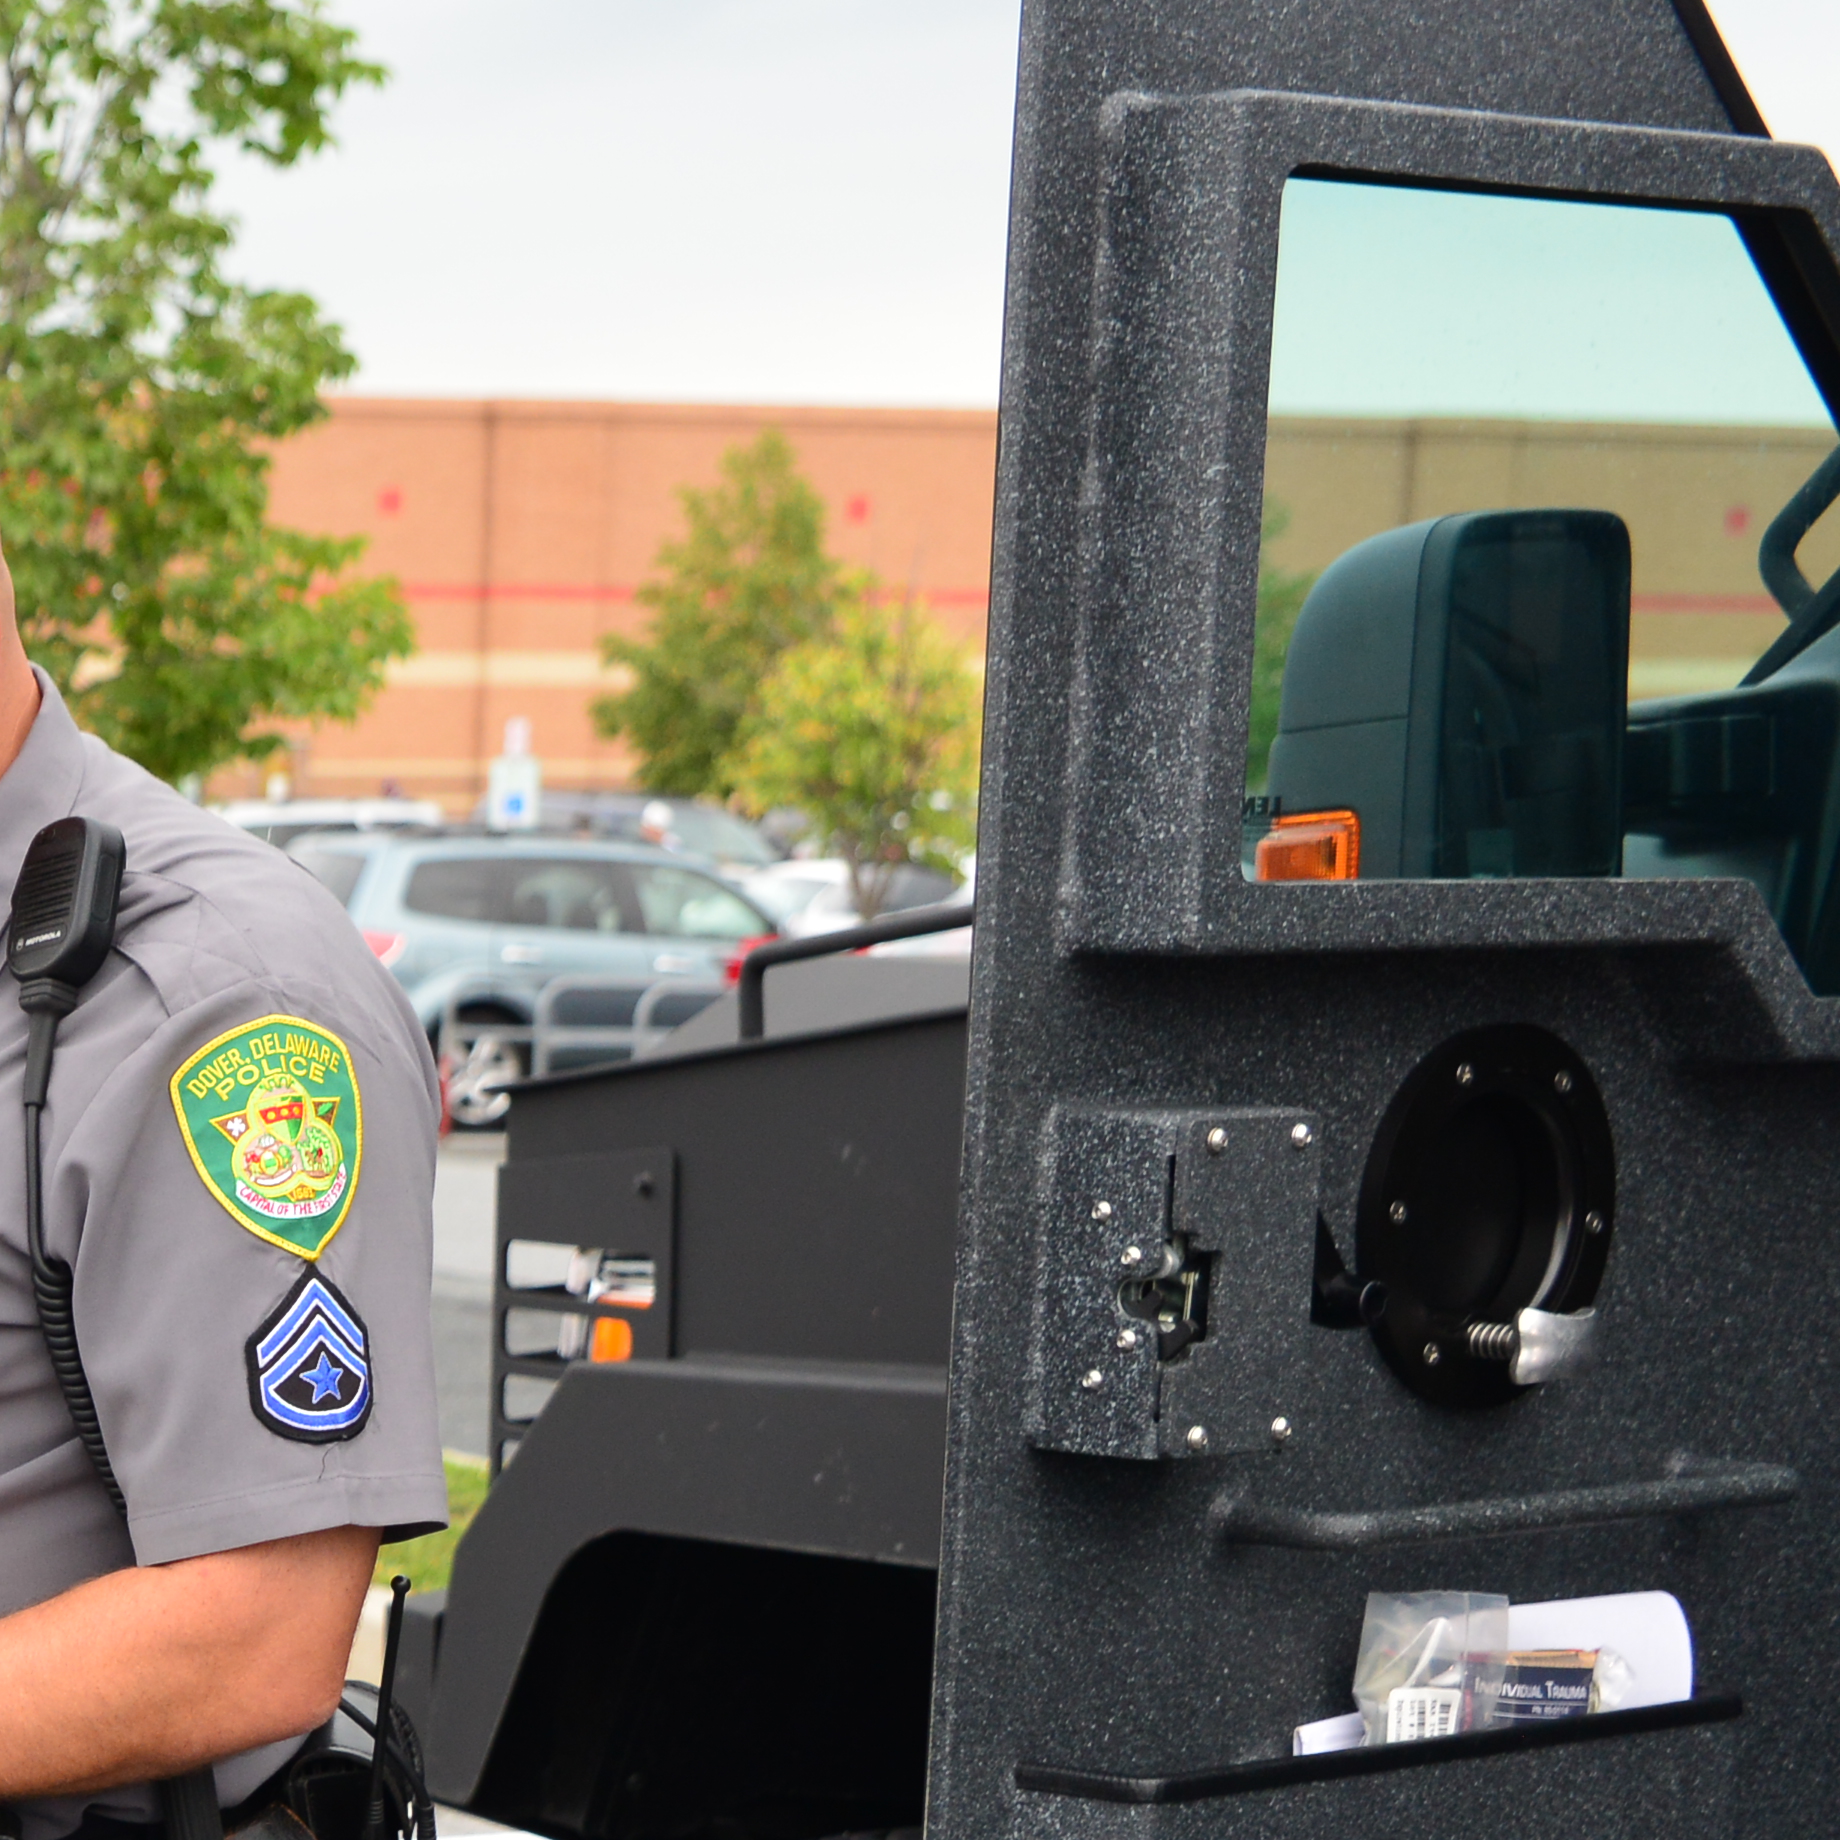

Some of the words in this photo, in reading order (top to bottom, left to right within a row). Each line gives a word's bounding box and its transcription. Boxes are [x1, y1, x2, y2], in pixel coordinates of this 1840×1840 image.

[25, 930, 62, 947] MOTOROLA
[248, 1032, 341, 1074] DELAWARE
[214, 1055, 327, 1101] POLICE
[239, 1186, 275, 1214] CAPITAL
[277, 1204, 289, 1216] OF
[293, 1203, 313, 1216] THE
[315, 1193, 334, 1213] FIRST
[1545, 1680, 1588, 1700] TRAUMA
